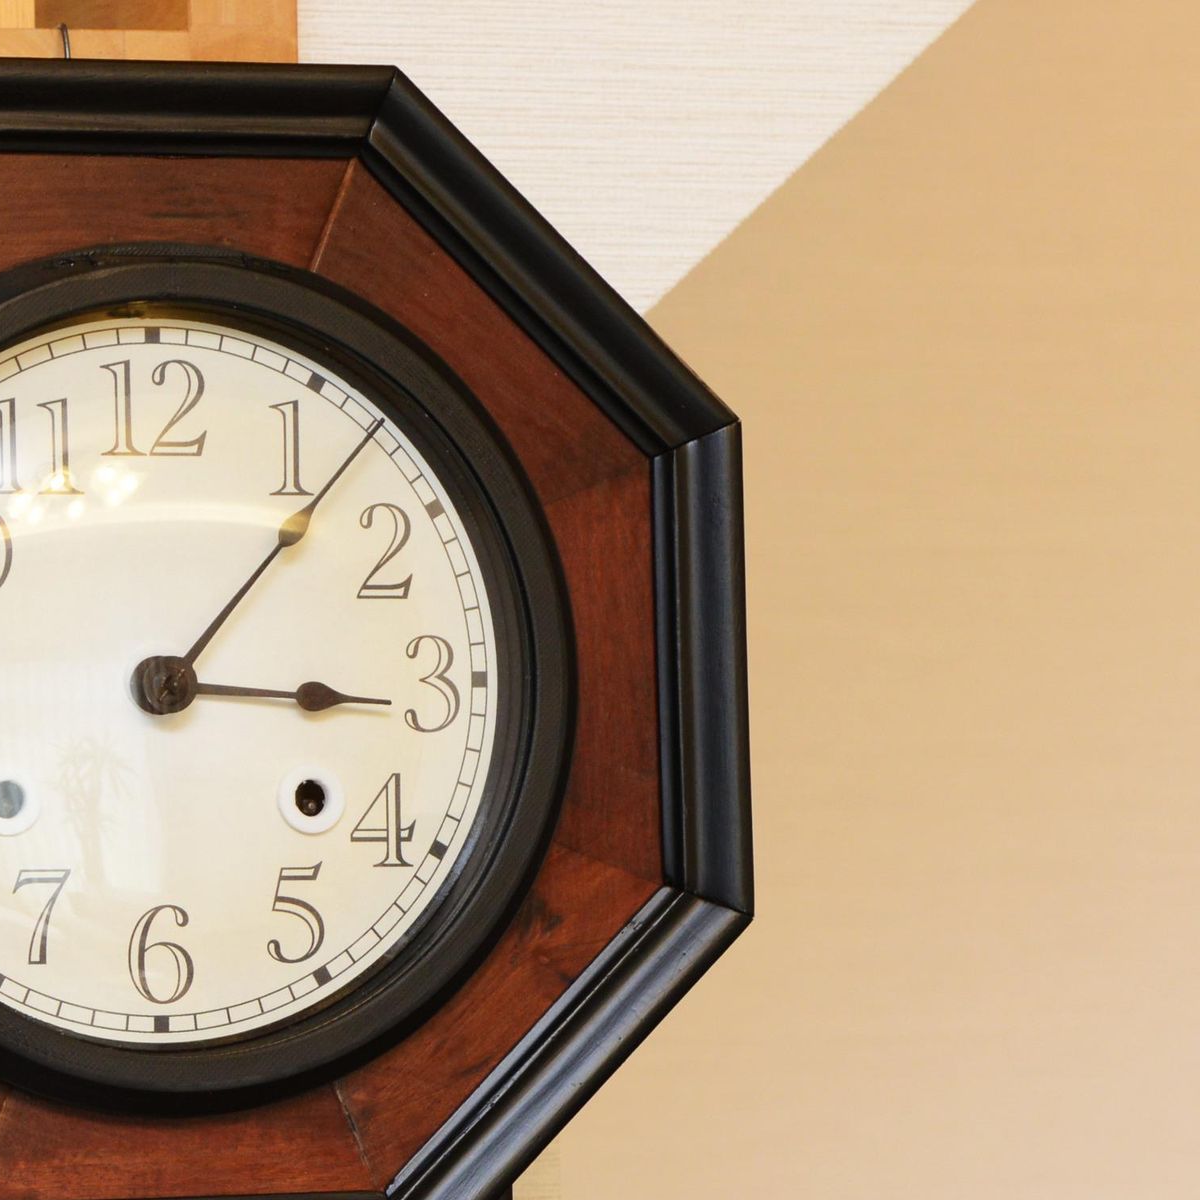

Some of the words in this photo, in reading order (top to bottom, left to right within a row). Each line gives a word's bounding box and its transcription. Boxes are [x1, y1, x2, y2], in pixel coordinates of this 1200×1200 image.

[100, 358, 209, 457] 12
[268, 400, 315, 497] 1
[356, 502, 413, 600] 2
[404, 634, 461, 732] 3
[350, 772, 415, 868] 4
[12, 868, 71, 965] 7
[128, 904, 194, 1004] 6
[267, 860, 326, 964] 5
